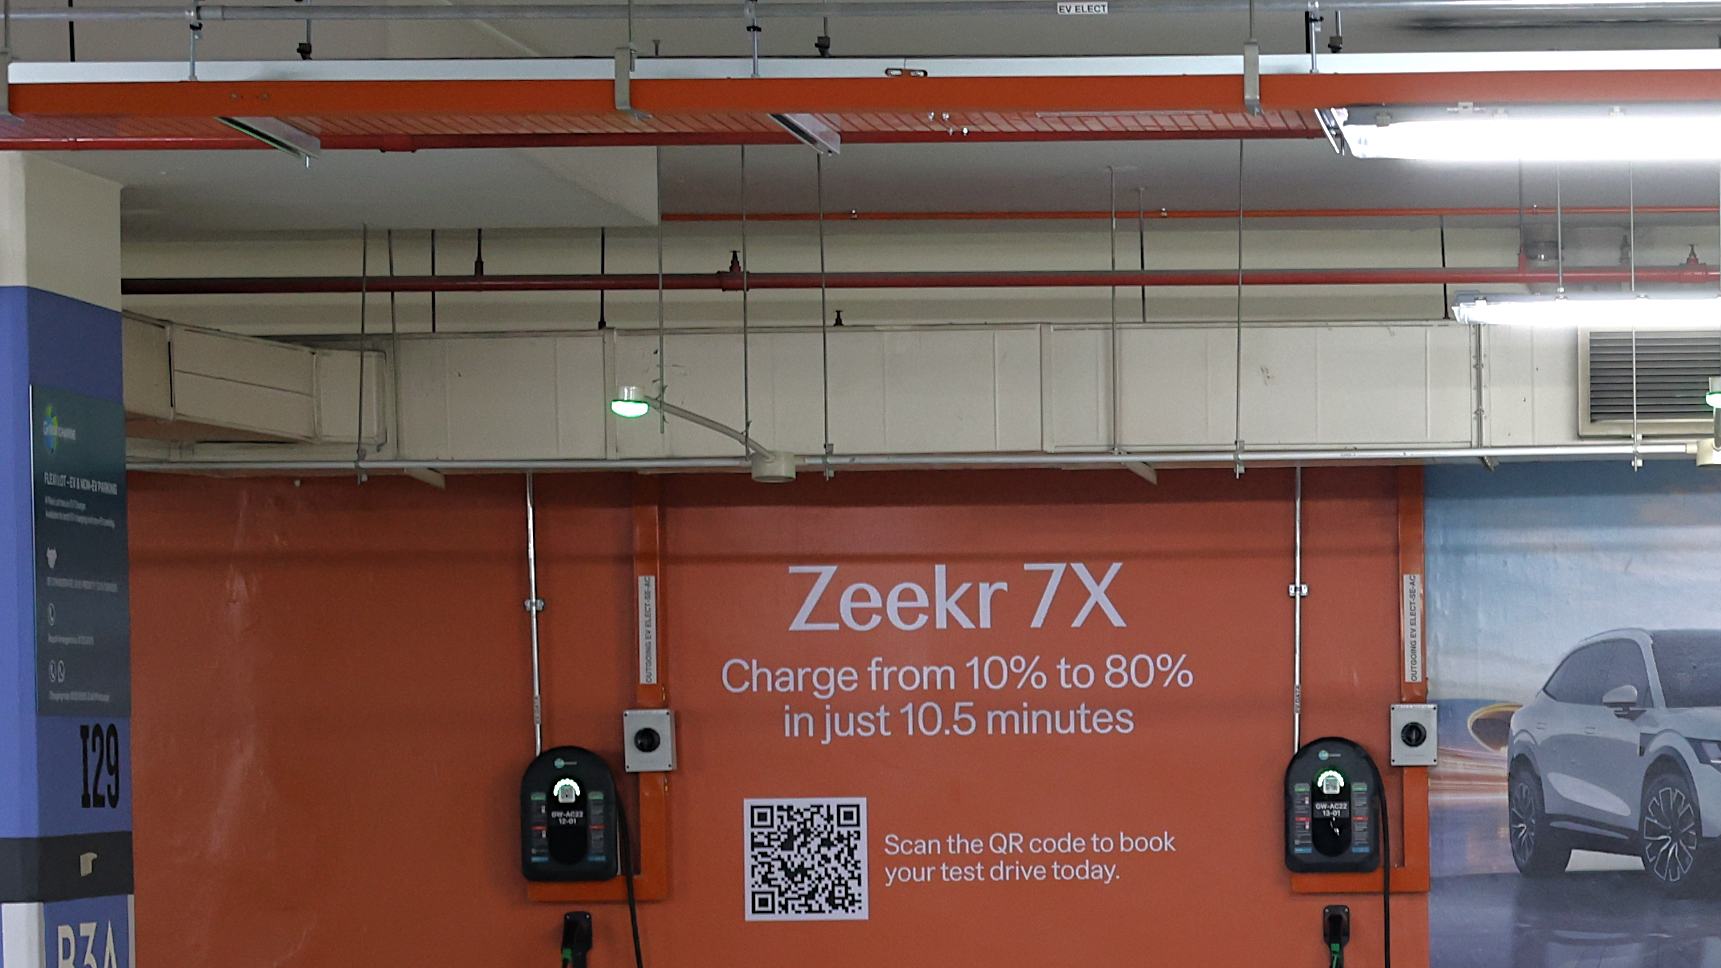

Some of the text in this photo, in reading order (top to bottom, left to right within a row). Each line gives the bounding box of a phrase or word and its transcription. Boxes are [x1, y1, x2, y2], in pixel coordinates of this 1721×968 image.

[1059, 4, 1106, 13] EV ELECT
[788, 562, 1127, 631] Zeekr 7X
[1410, 628, 1416, 638] EV
[722, 654, 1194, 699] Charge from 10% to 80%
[784, 702, 1135, 745] in just 10.5 minutes
[80, 724, 120, 809] I29
[884, 830, 1177, 856] Scan the QR code to book
[884, 858, 1120, 887] your test drive today.
